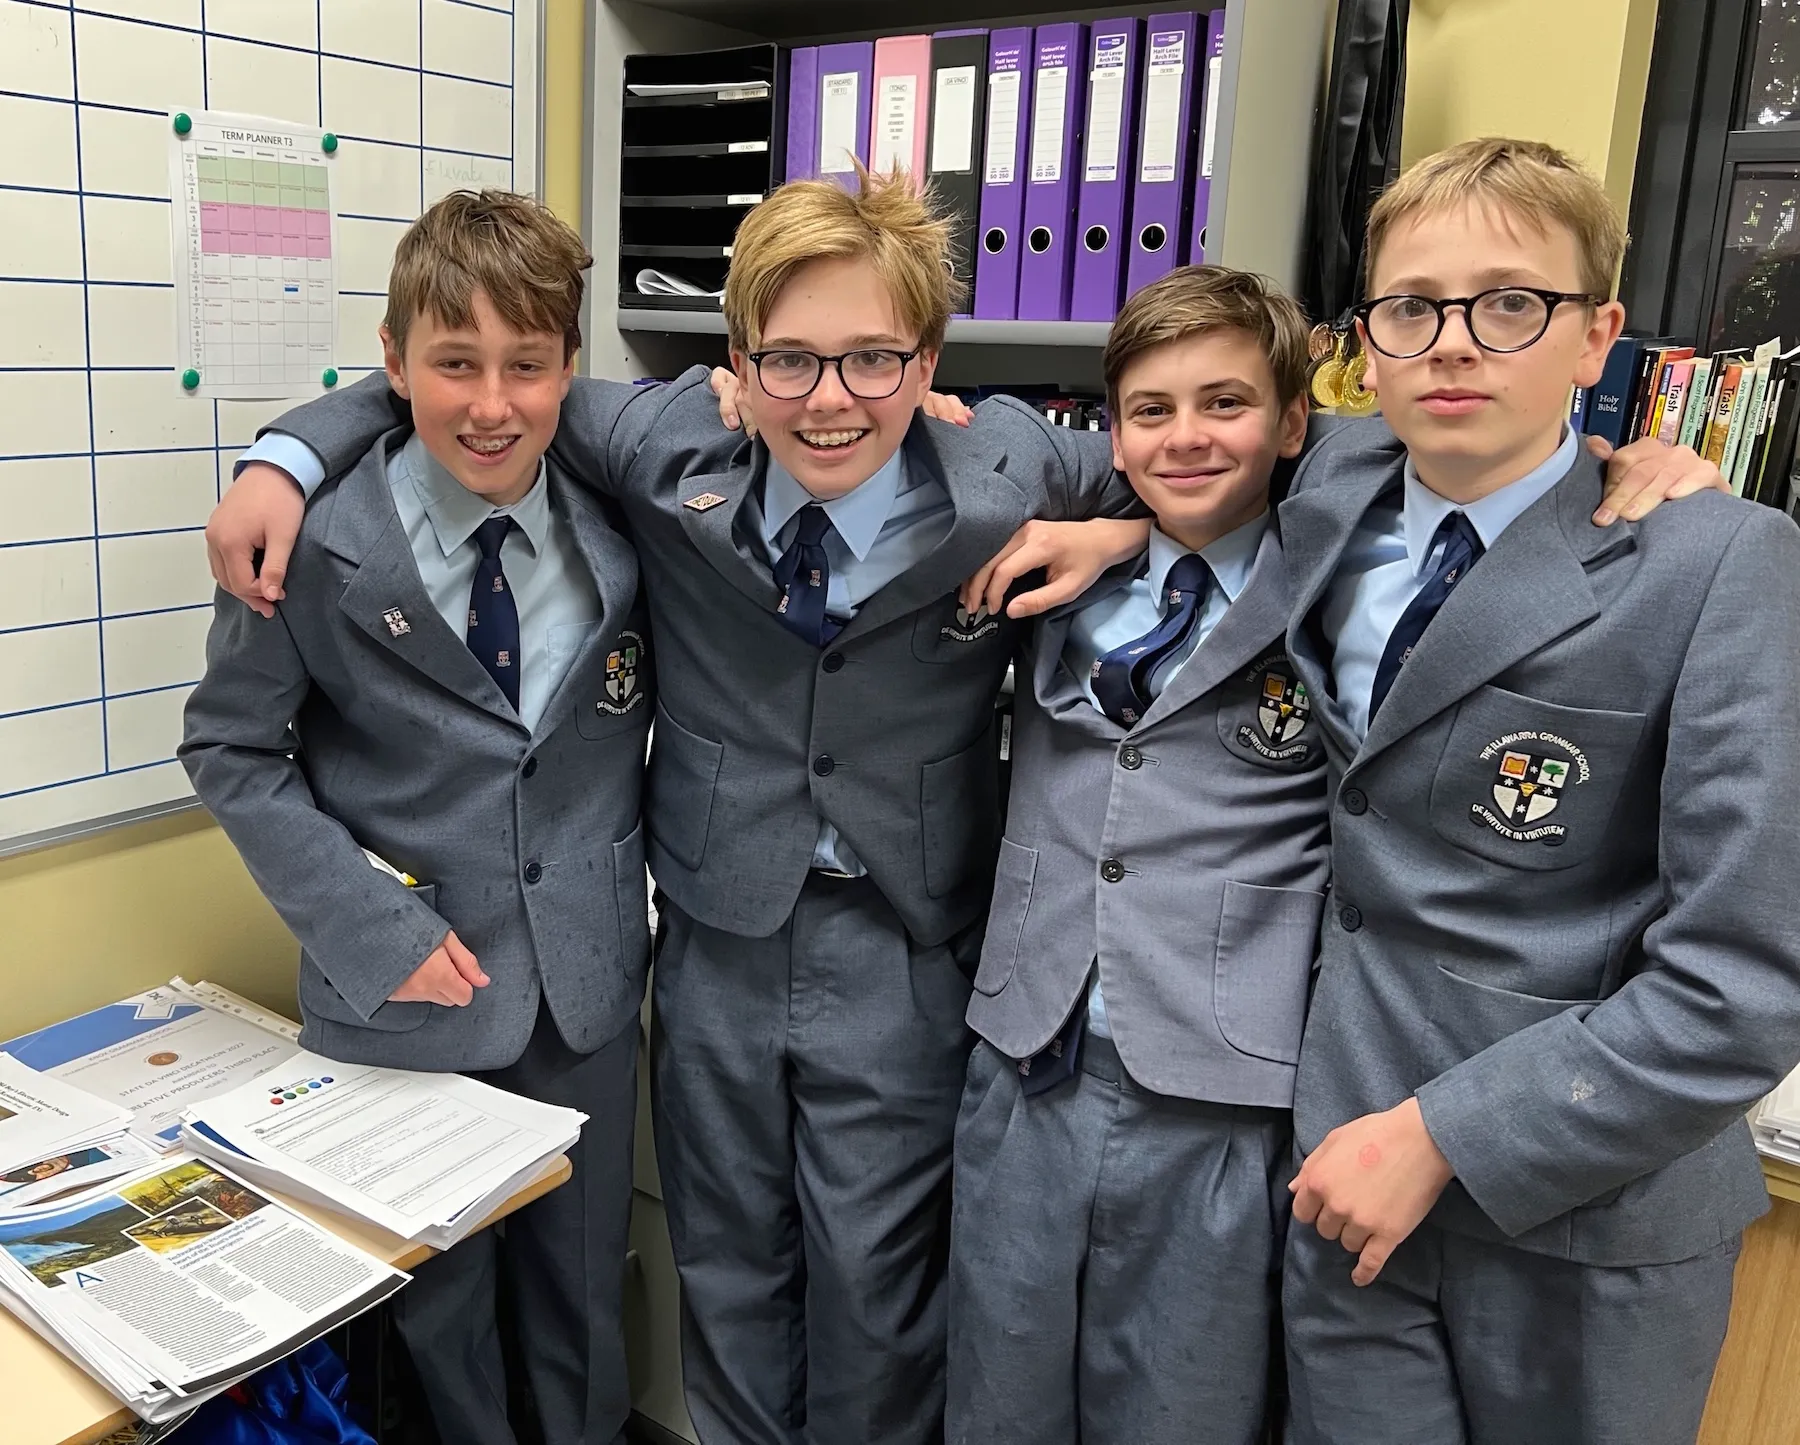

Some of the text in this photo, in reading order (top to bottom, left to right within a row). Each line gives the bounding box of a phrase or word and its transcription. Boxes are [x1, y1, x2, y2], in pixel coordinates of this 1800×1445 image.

[222, 130, 293, 146] TERM PLANNER T3
[1598, 404, 1618, 412] Bible
[1599, 394, 1619, 405] Holy
[1667, 382, 1683, 412] Trash
[1688, 395, 1700, 423] Fitzgerald
[1720, 386, 1735, 416] Trash
[1734, 396, 1744, 423] Steinbeck
[1749, 400, 1760, 429] Fitzgerald
[1240, 726, 1249, 735] DE
[1249, 733, 1268, 756] VIRTUTE
[1479, 731, 1591, 784] THE ILLAWARRA GRAMMAR SCHOOL
[1472, 803, 1565, 840] DE VIRTUTE IN VIRTUTEM
[119, 1083, 145, 1097] STATE
[146, 1078, 158, 1086] DA
[158, 1068, 179, 1080] VINCI
[180, 1050, 227, 1073] DECATHLON
[170, 1069, 225, 1095] PRODUCERS
[224, 1057, 252, 1070] THIRD
[252, 1045, 280, 1059] PLACE
[76, 1272, 104, 1288] A
